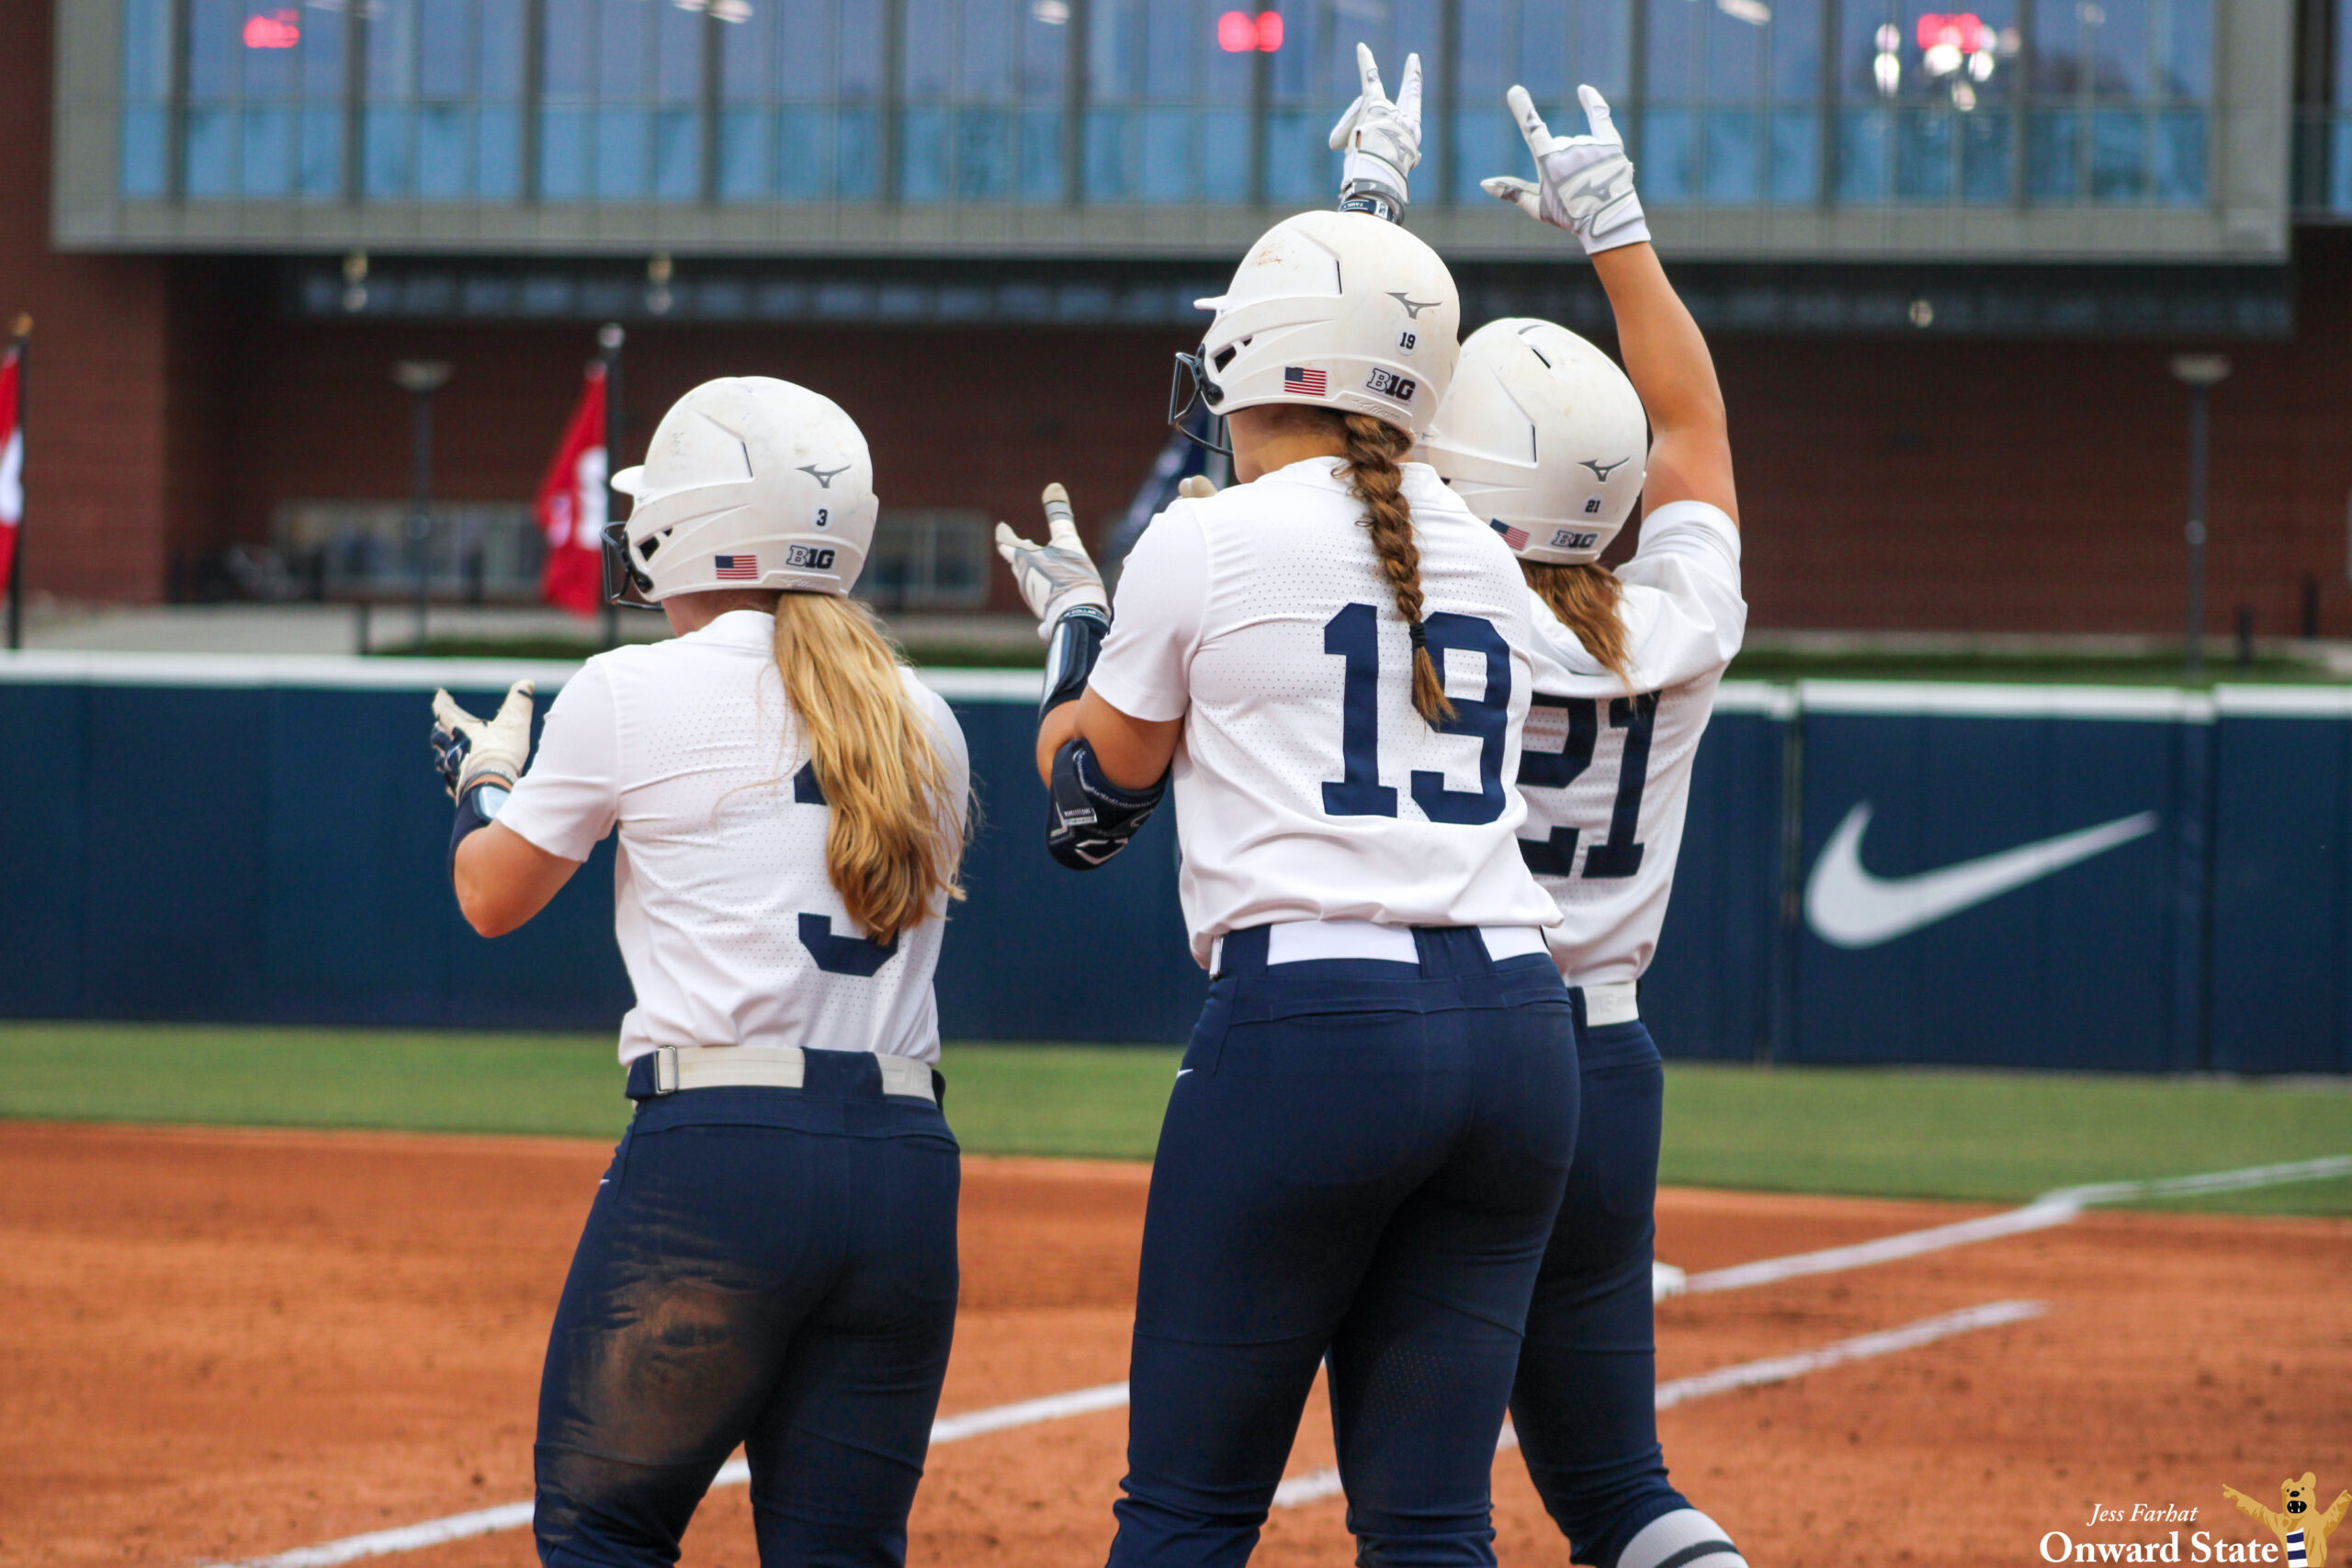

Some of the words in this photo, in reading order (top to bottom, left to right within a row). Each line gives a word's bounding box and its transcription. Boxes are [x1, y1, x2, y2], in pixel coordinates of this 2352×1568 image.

[1399, 332, 1417, 350] 19
[1584, 499, 1600, 513] 21
[816, 508, 829, 527] 3
[1321, 602, 1512, 826] 19
[1516, 688, 1663, 879] 21
